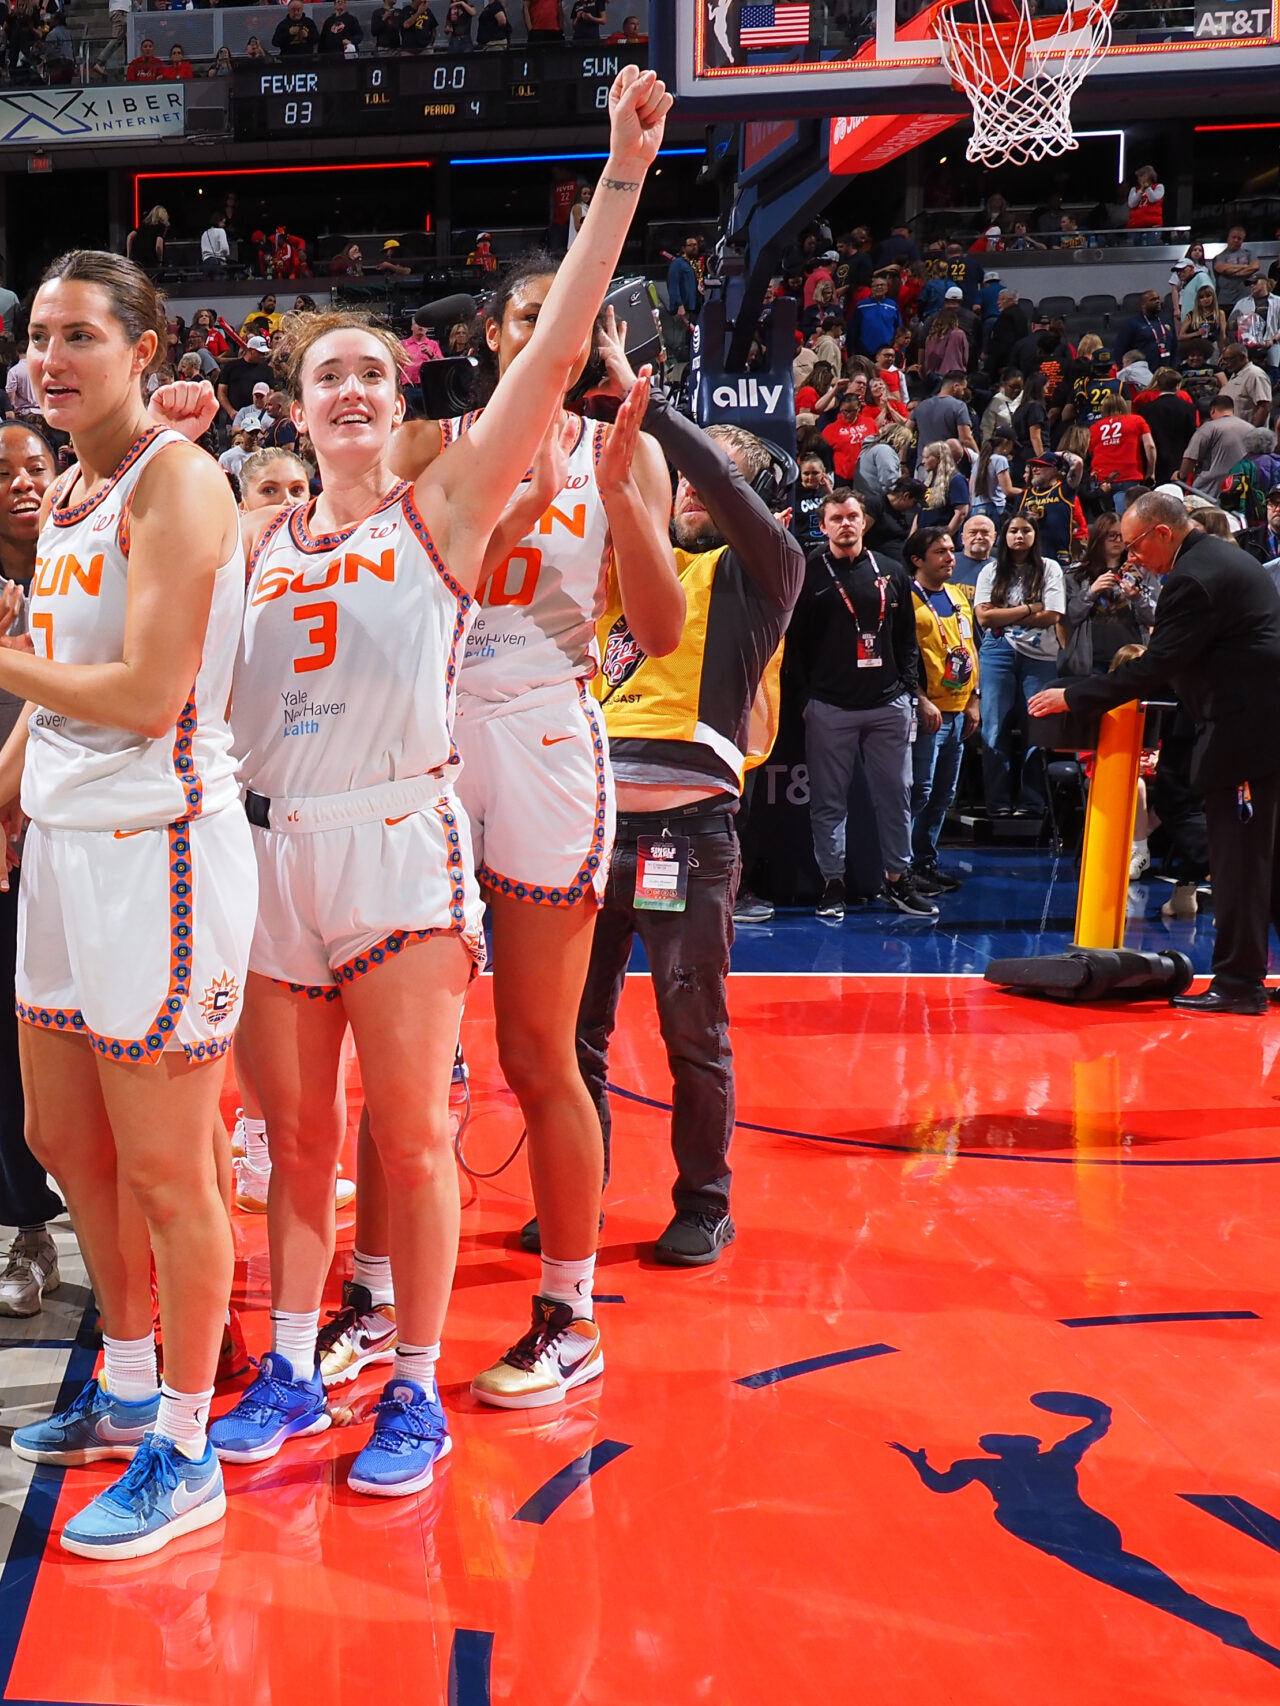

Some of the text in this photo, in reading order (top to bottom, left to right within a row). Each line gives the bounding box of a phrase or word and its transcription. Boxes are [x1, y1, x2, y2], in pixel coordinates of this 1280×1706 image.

[1195, 9, 1270, 37] AT&T
[522, 63, 528, 77] 1
[583, 57, 618, 76] SUN
[261, 73, 318, 94] FEVER
[372, 69, 382, 86] 0
[433, 66, 466, 90] 0.0
[82, 93, 182, 118] XIBER
[285, 101, 313, 124] 83
[424, 104, 456, 115] PERIOD
[470, 101, 480, 115] 4
[96, 112, 181, 131] INTERNET
[951, 263, 966, 276] 22
[713, 379, 783, 414] ally
[1100, 422, 1123, 440] 22
[251, 548, 395, 607] SUN
[293, 600, 338, 673] 3
[281, 690, 308, 706] Yale
[765, 764, 811, 805] T&
